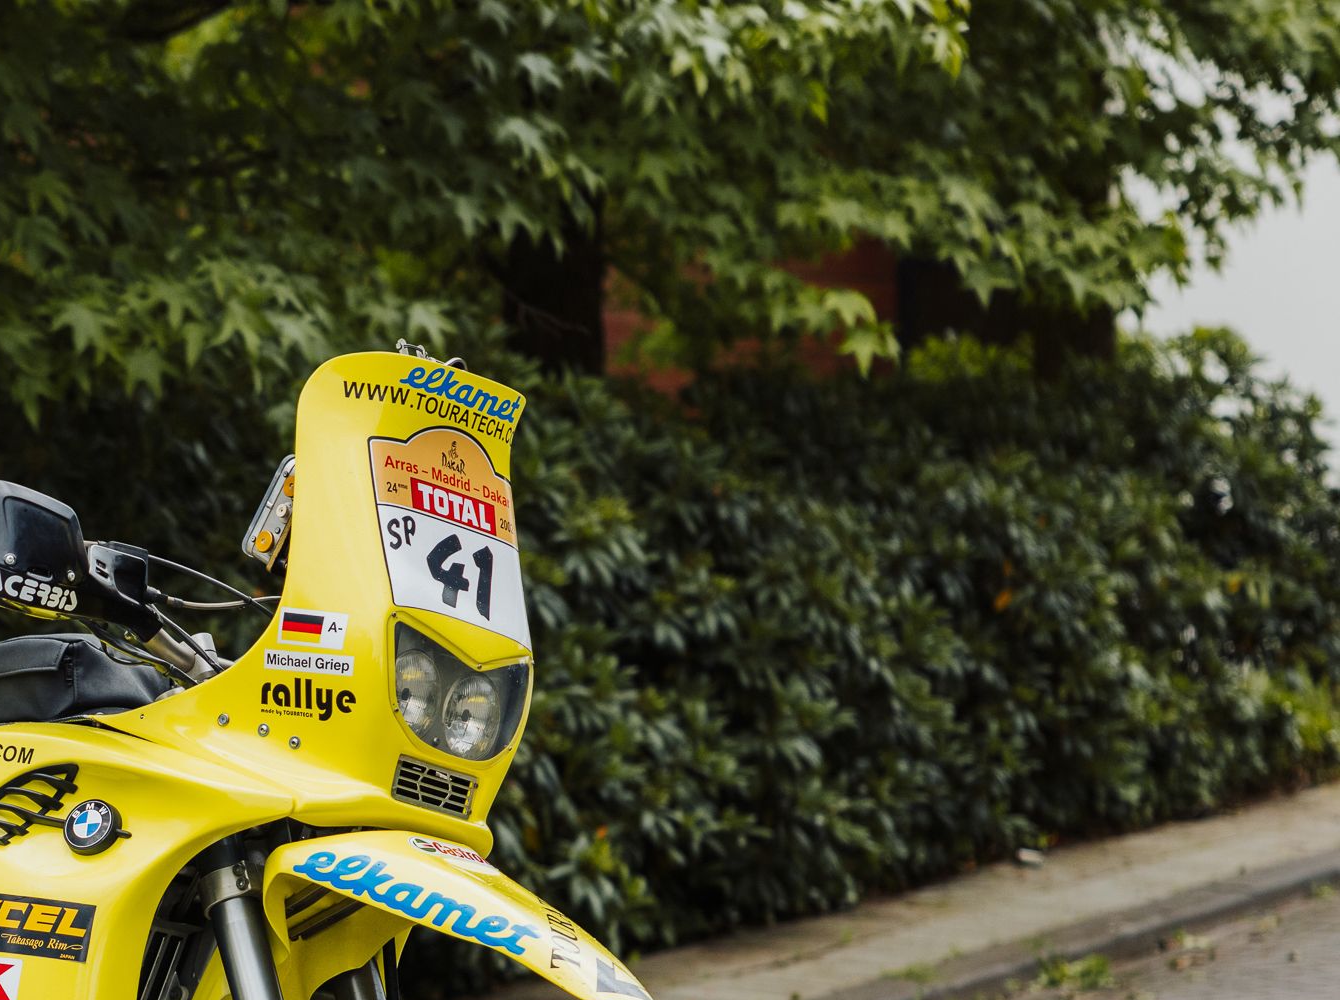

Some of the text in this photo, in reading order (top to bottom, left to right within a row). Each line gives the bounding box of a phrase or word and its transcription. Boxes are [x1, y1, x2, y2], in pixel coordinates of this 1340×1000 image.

[343, 380, 515, 447] WWW.TOURATECH.C
[400, 367, 521, 423] elkamet
[384, 455, 419, 474] Arras
[431, 467, 471, 492] Madrid
[417, 481, 492, 532] TOTAL
[386, 515, 417, 551] SP
[426, 533, 494, 621] 41
[327, 621, 343, 633] A-
[266, 653, 350, 674] Michael Griep
[260, 677, 357, 721] rallye
[276, 708, 282, 717] by
[71, 802, 109, 819] BMW
[293, 851, 543, 956] elkamet
[0, 933, 77, 951] Takasago Rim
